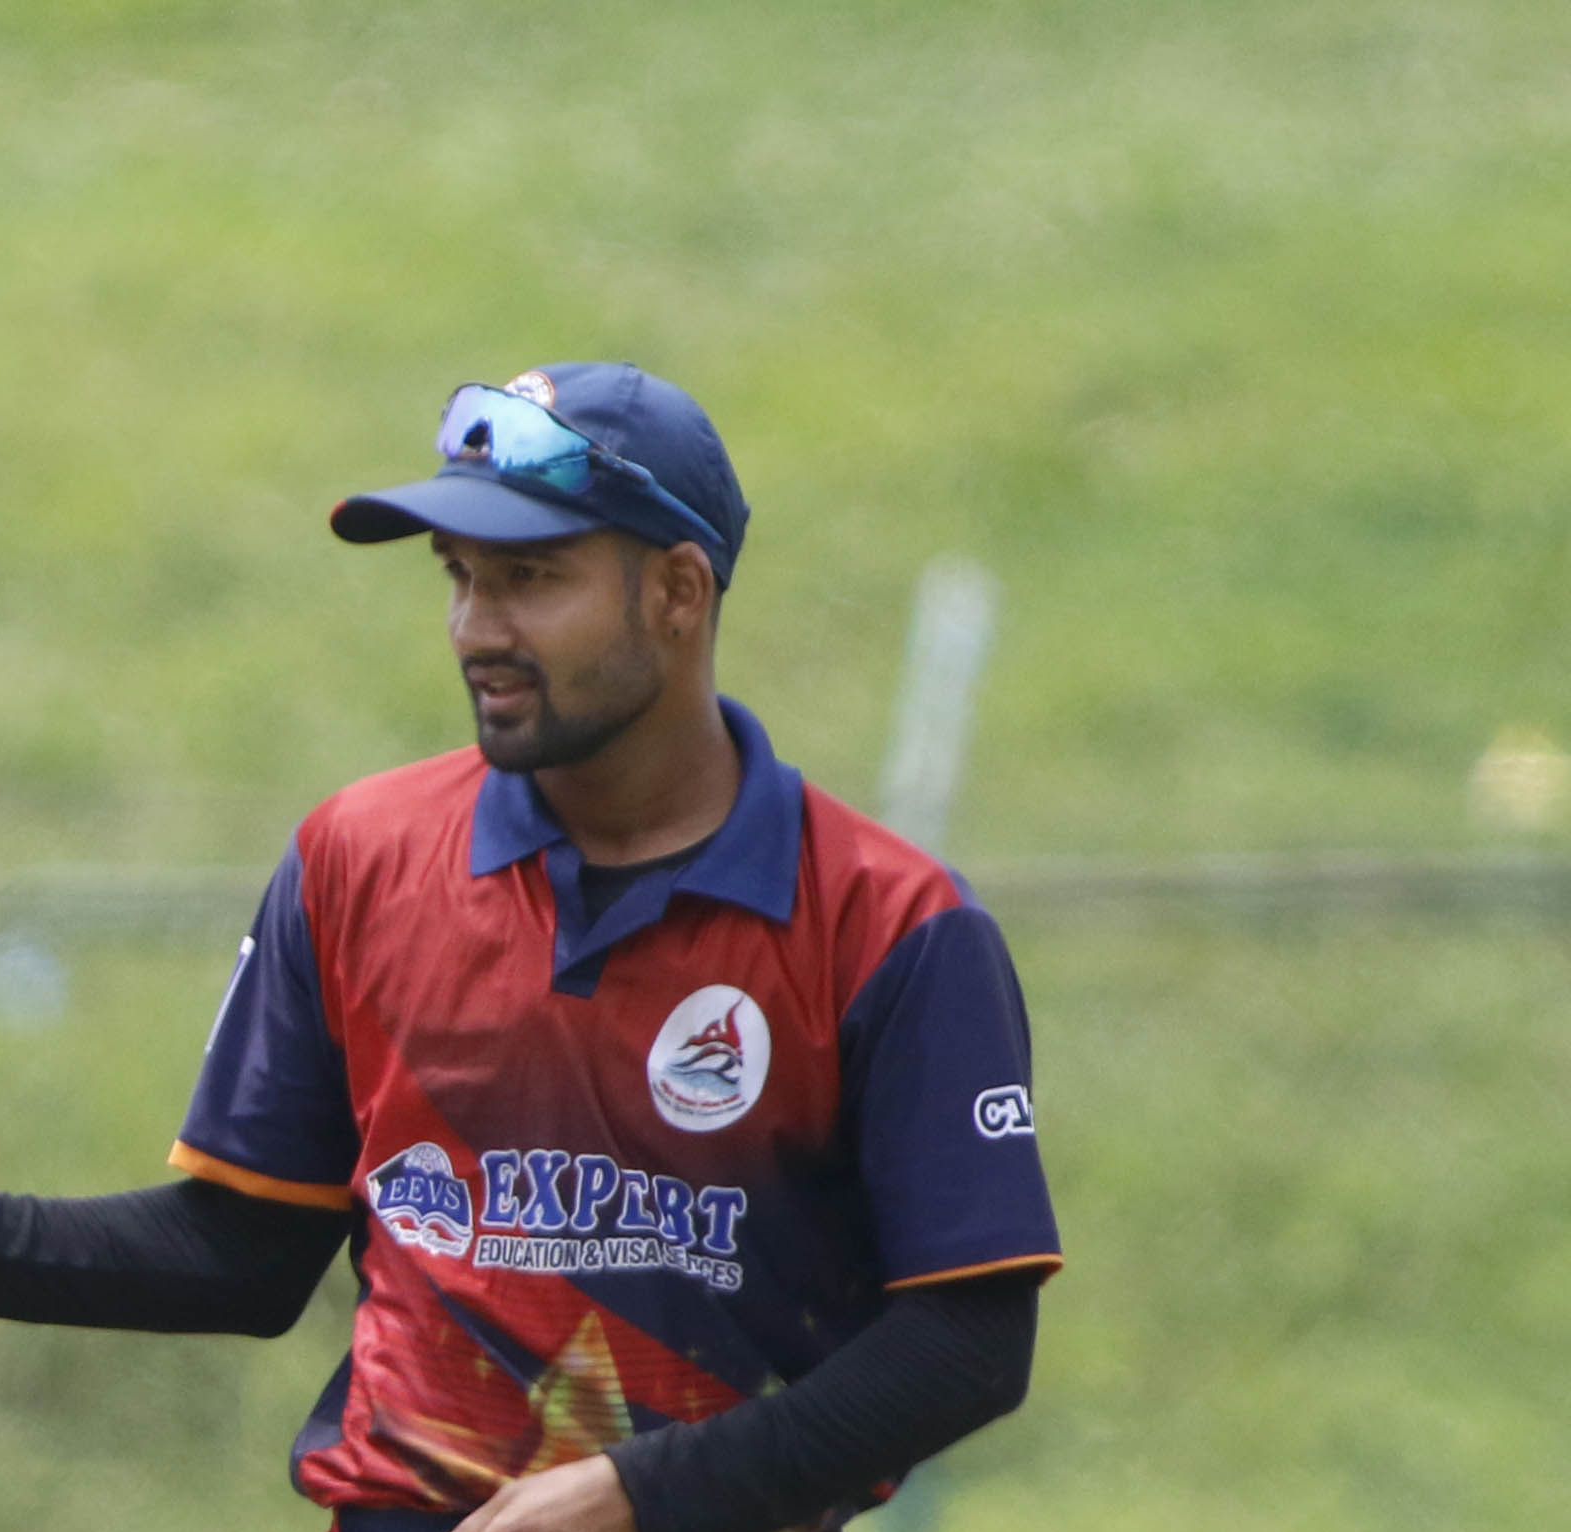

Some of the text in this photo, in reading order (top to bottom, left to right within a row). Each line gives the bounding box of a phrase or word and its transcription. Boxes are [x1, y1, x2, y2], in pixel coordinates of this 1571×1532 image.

[388, 1175, 460, 1210] EEVS
[479, 1149, 747, 1254] EXPERT
[476, 1237, 577, 1270] EDUCATION
[582, 1238, 603, 1269] &
[607, 1239, 661, 1269] VISA
